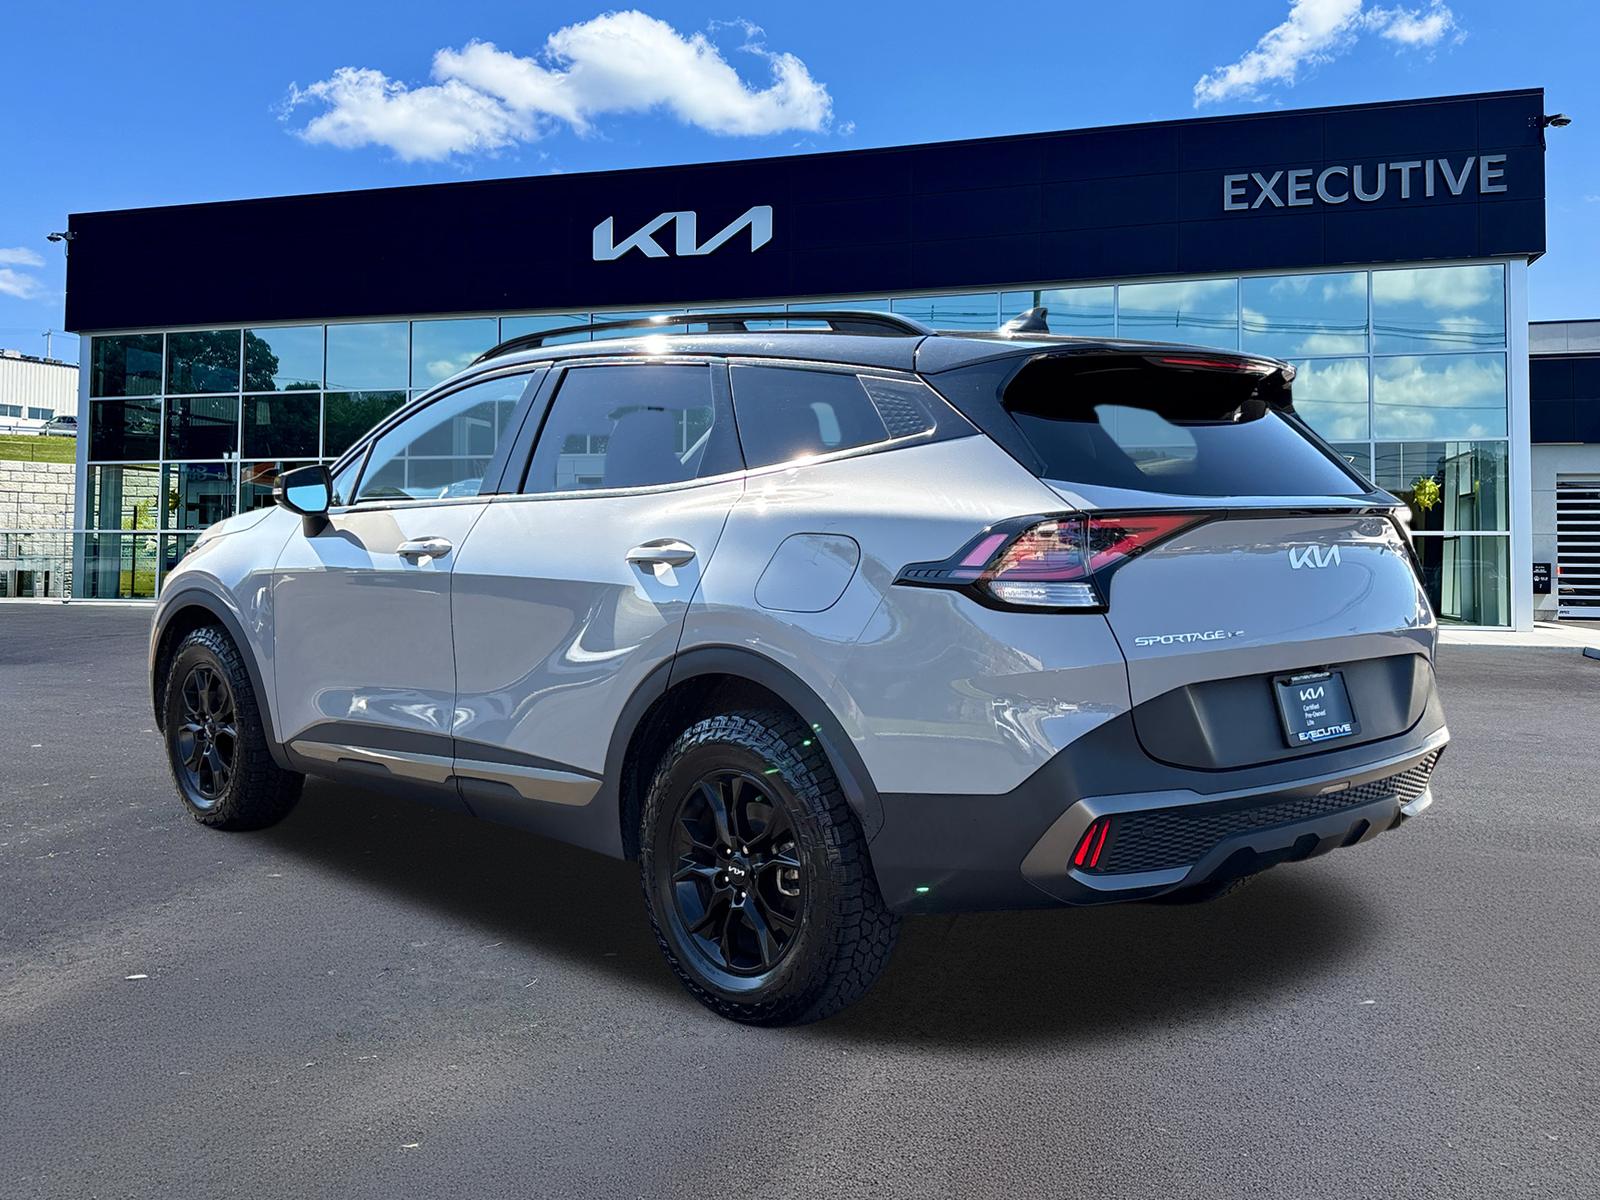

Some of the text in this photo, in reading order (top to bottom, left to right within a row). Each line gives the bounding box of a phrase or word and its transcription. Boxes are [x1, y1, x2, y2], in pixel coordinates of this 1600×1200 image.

[1224, 154, 1508, 211] EXECUTIVE
[593, 205, 773, 261] KIA
[1289, 544, 1341, 569] KIA
[1134, 629, 1226, 647] SPORTAGE
[1299, 686, 1325, 701] KIA
[1298, 723, 1352, 741] EXECUTIVE
